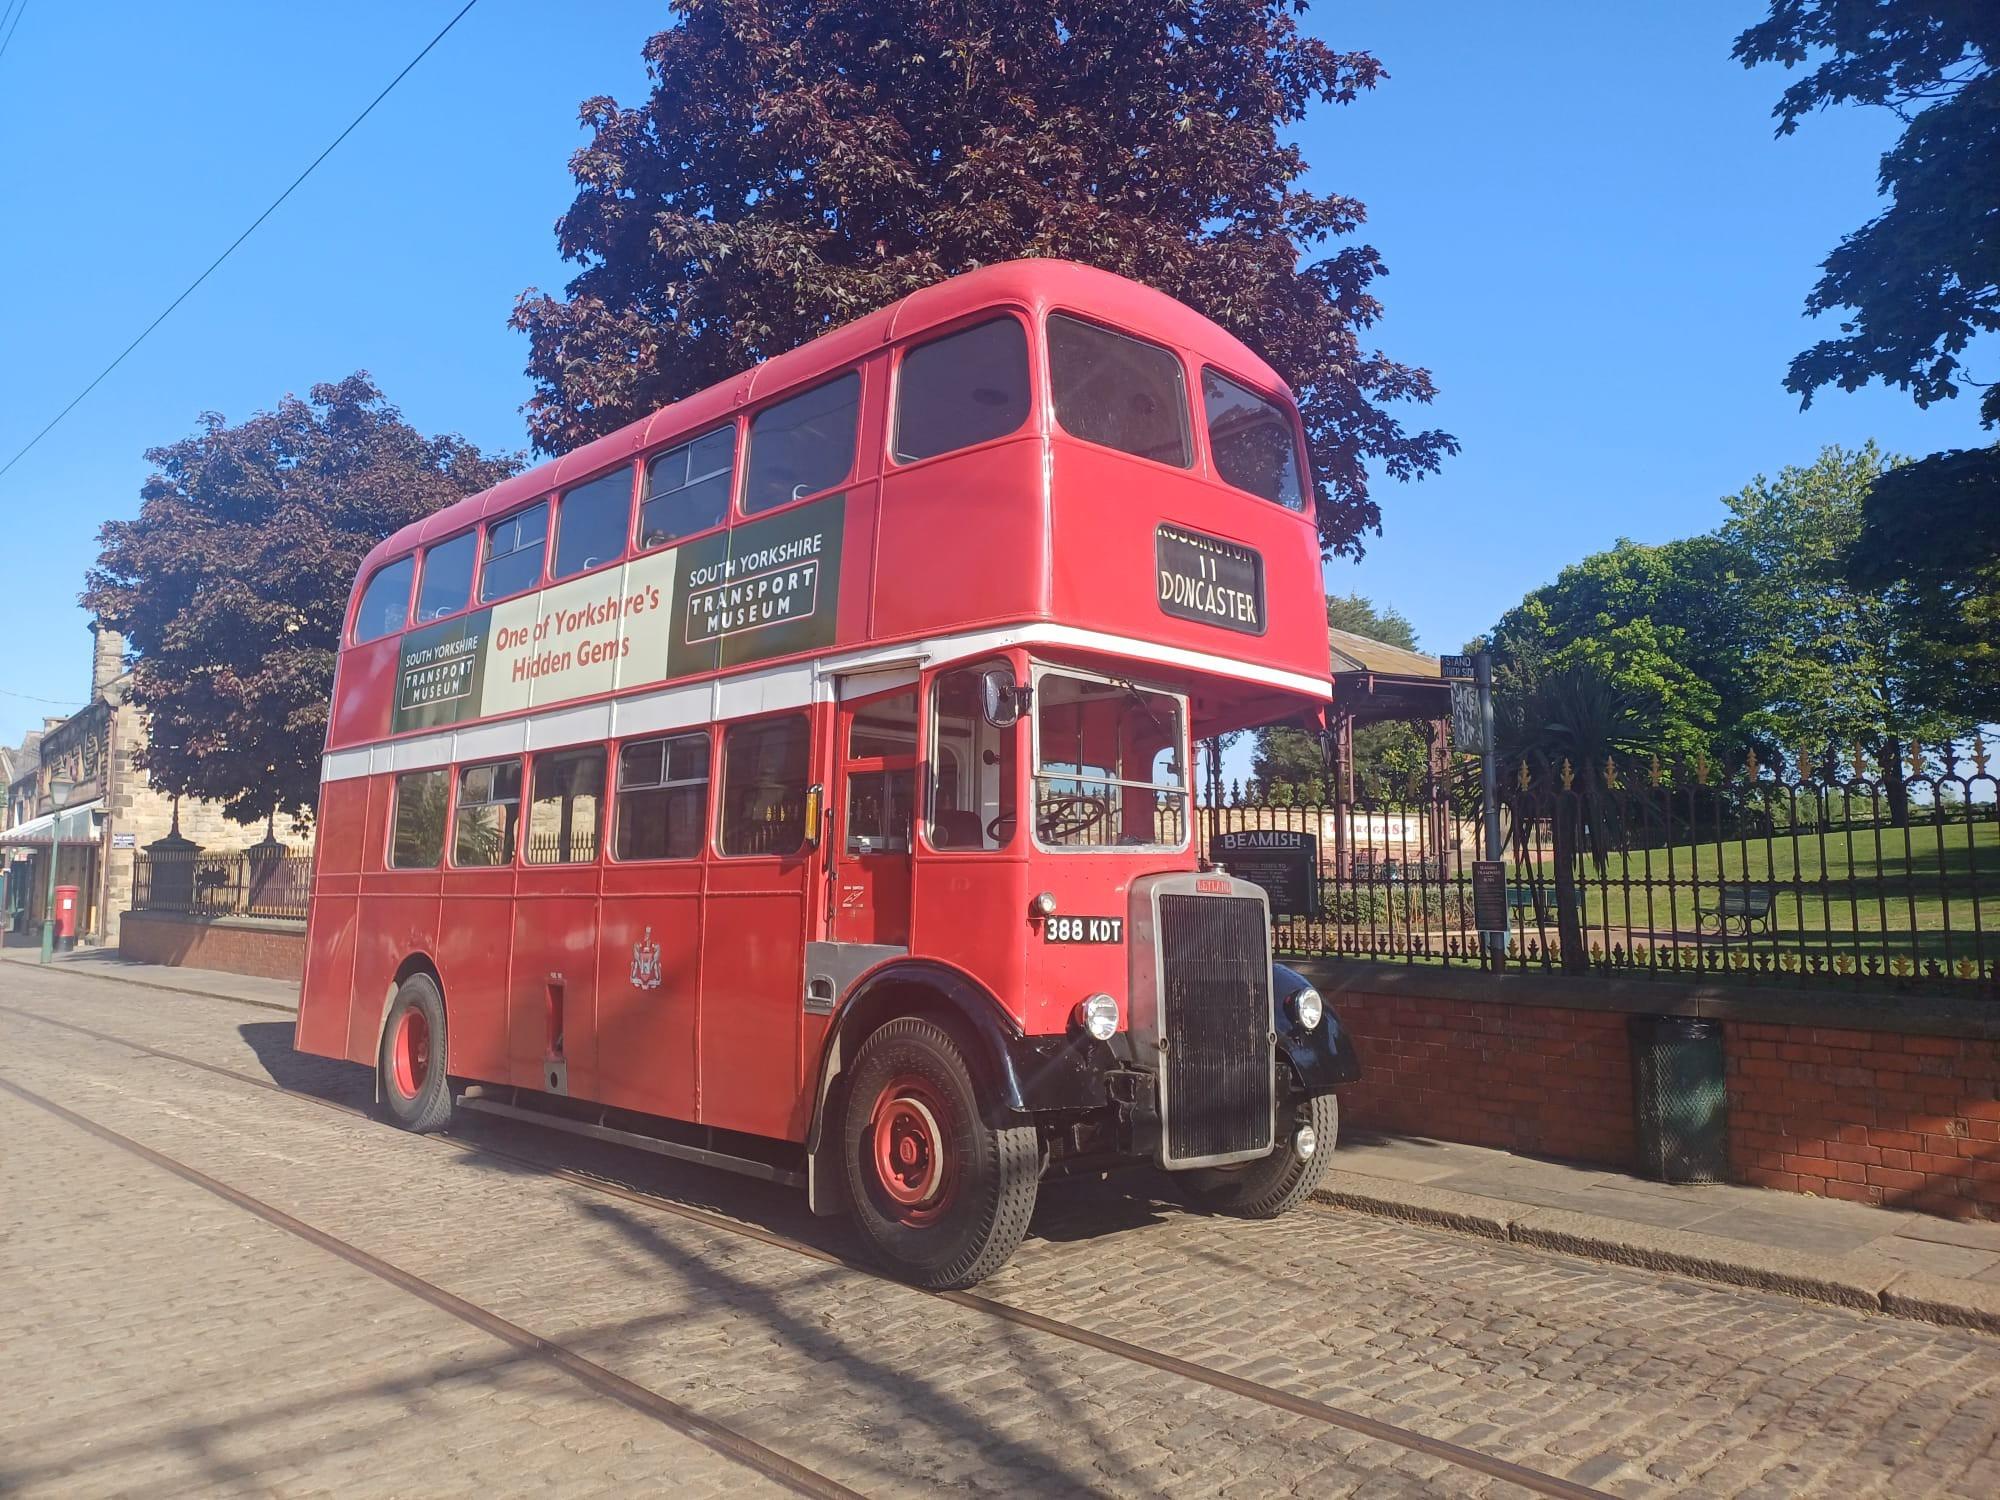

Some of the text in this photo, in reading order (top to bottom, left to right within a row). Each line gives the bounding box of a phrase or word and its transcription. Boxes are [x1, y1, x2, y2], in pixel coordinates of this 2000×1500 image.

[689, 533, 822, 588] SOUTH YORKSHIRE
[1200, 555, 1216, 581] 11
[691, 567, 814, 615] TRANSPORT
[1160, 570, 1257, 623] DONCASTER
[496, 585, 660, 651] One of Yorkshire's
[707, 596, 790, 632] MUSEUM
[406, 635, 478, 667] SOUTH YORKSHIRE
[511, 637, 630, 682] Hidden Gems
[1445, 656, 1471, 667] STAND
[406, 660, 473, 688] TRANSPORT
[413, 680, 459, 702] MUSEUM
[1224, 832, 1301, 849] BEAMISH
[1047, 918, 1121, 942] 388 KDT
